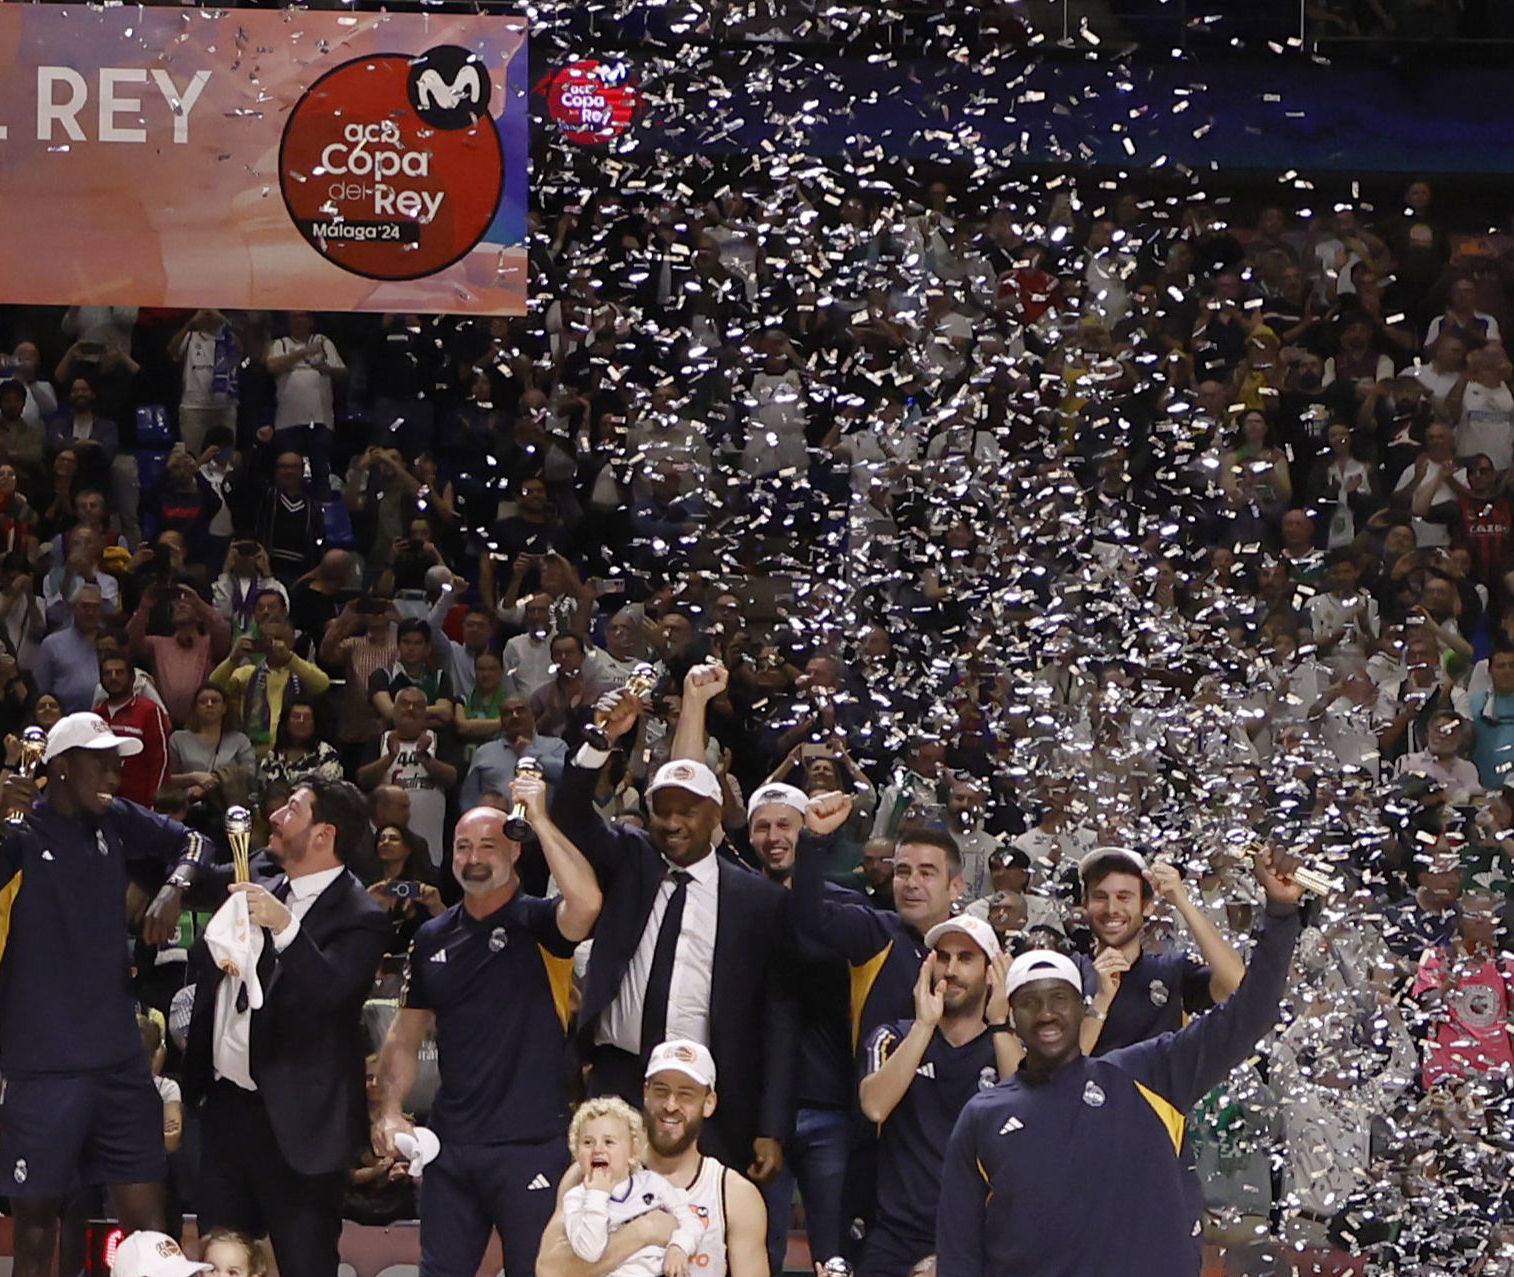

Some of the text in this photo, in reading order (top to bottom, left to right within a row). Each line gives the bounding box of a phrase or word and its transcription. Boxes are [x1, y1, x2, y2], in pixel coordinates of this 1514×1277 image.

[37, 66, 213, 145] REY
[344, 119, 401, 144] acb
[321, 142, 429, 181] Copa
[374, 187, 445, 223] Rey
